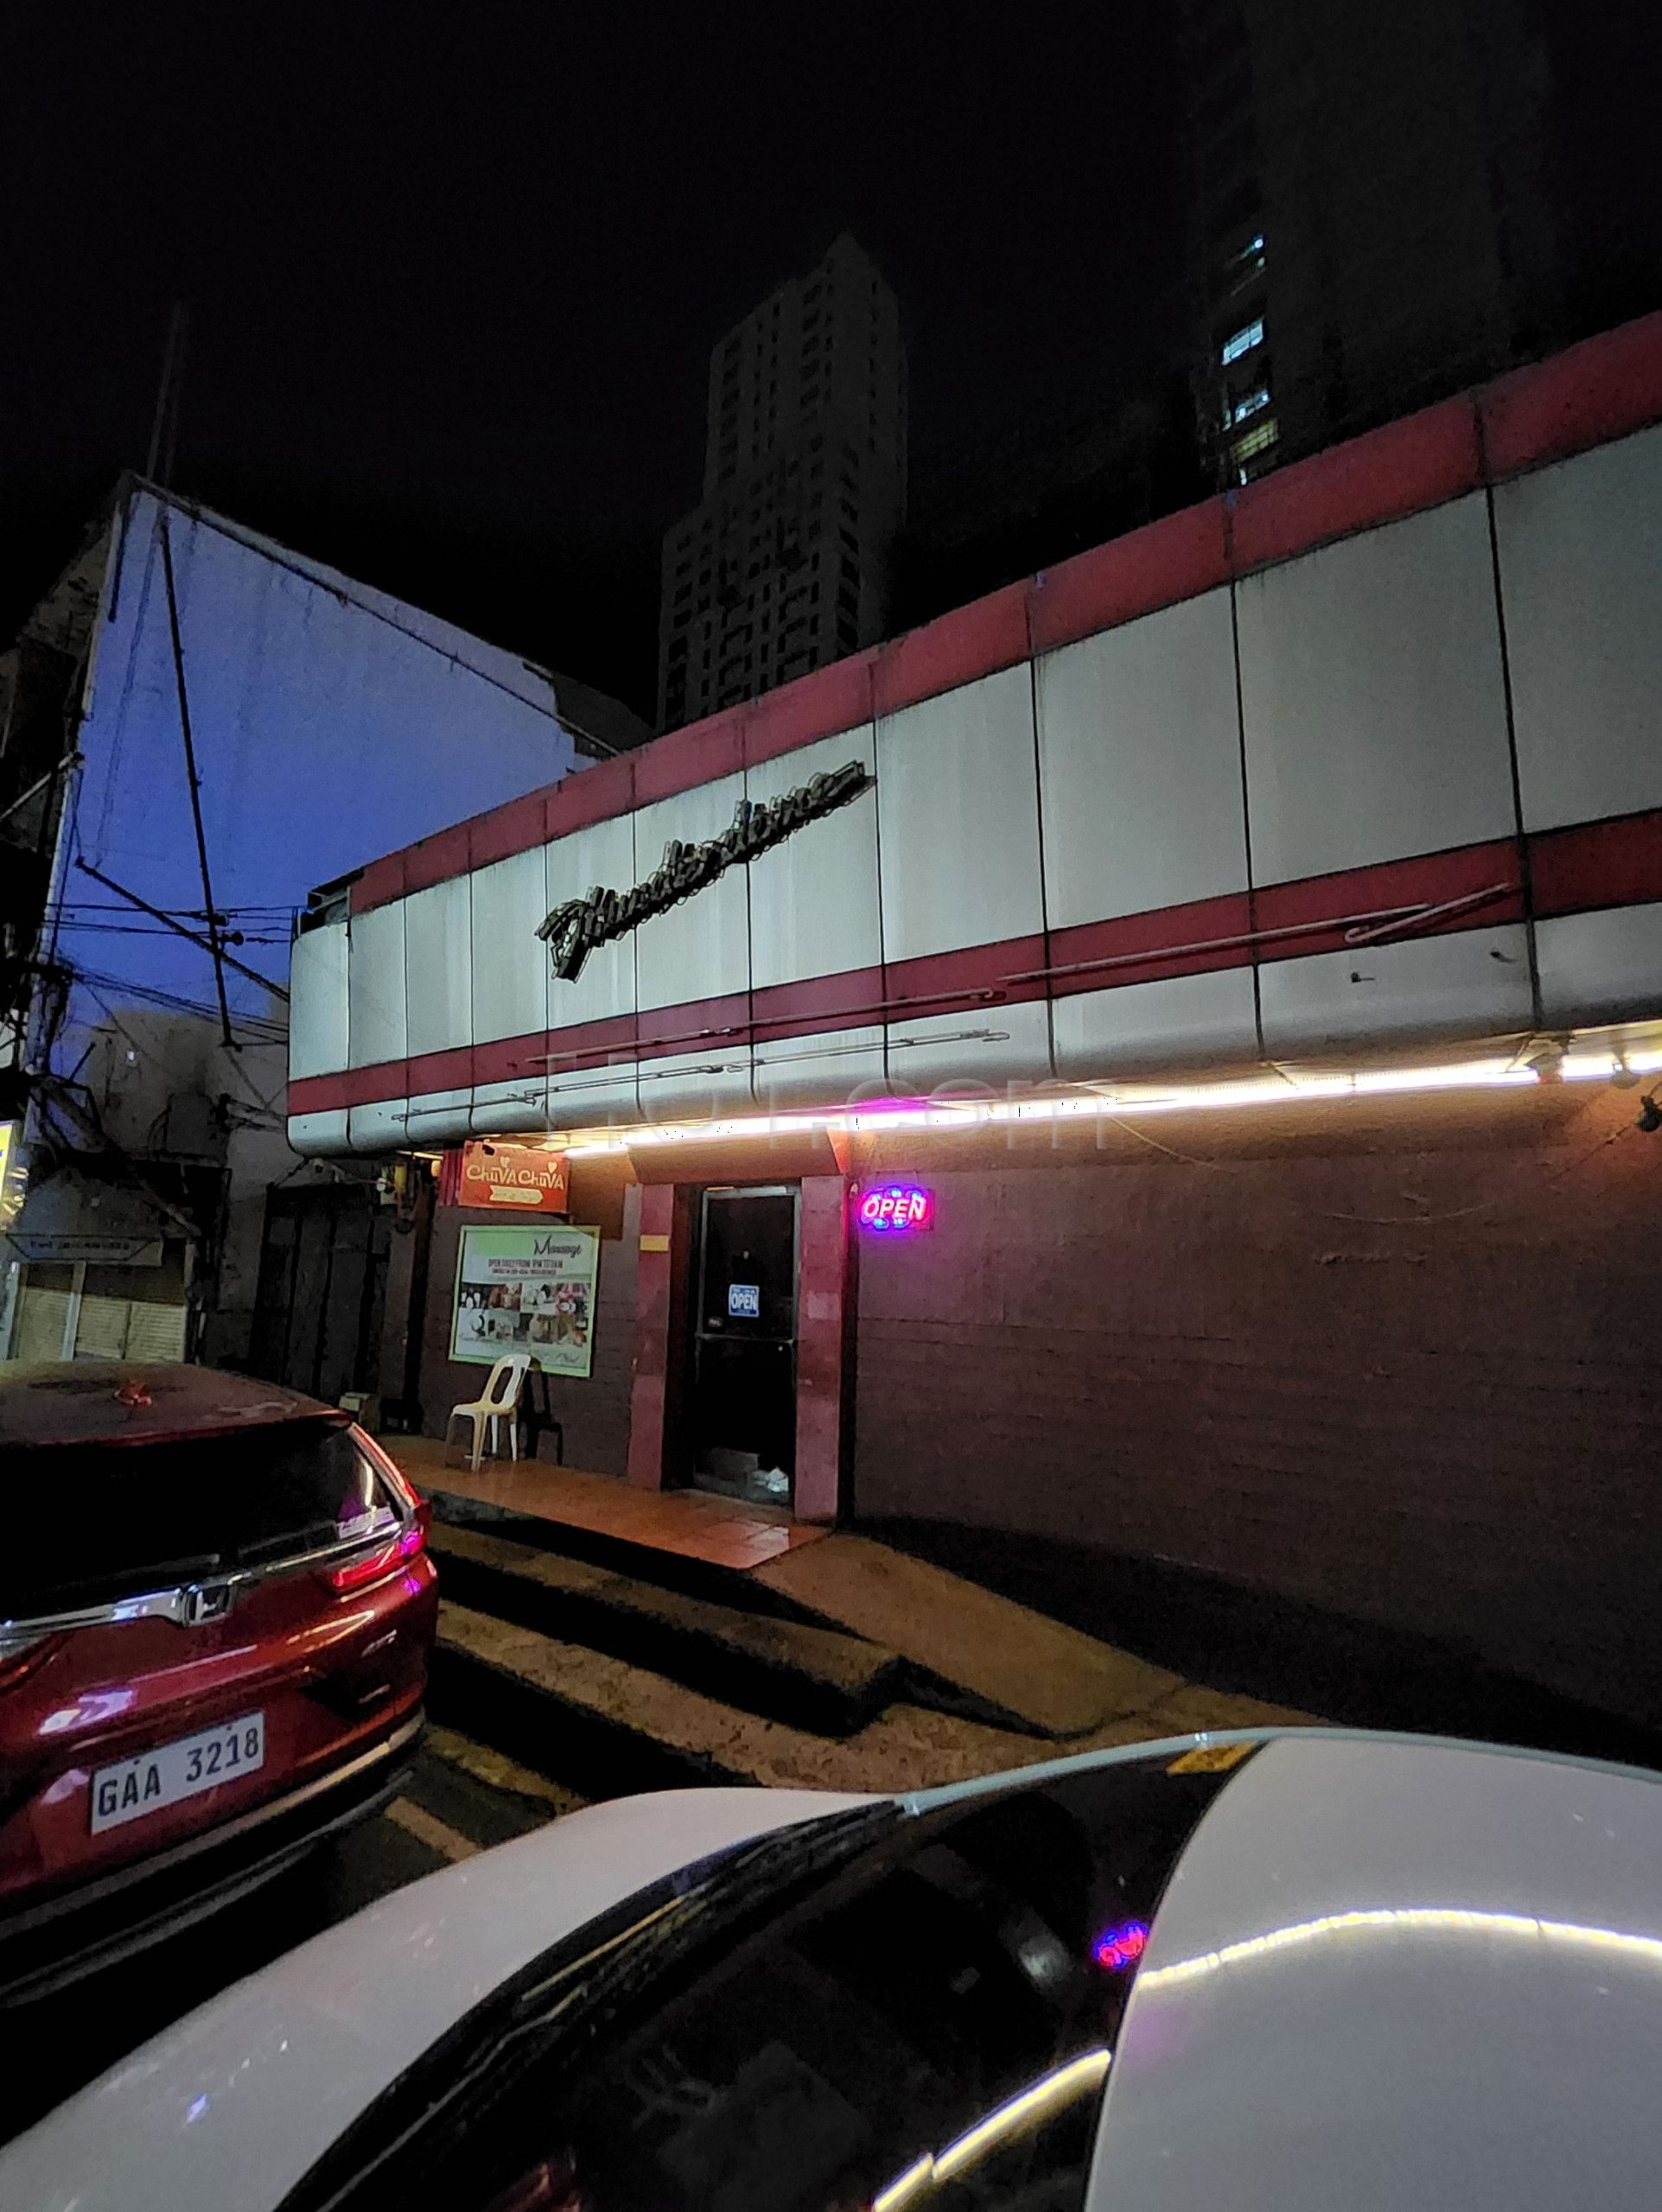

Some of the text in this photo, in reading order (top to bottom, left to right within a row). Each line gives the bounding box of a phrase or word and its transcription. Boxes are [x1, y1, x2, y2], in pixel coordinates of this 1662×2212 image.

[863, 1197, 927, 1221] OPEN
[731, 1293, 757, 1310] OPEN
[98, 1727, 259, 1816] GAA 3218
